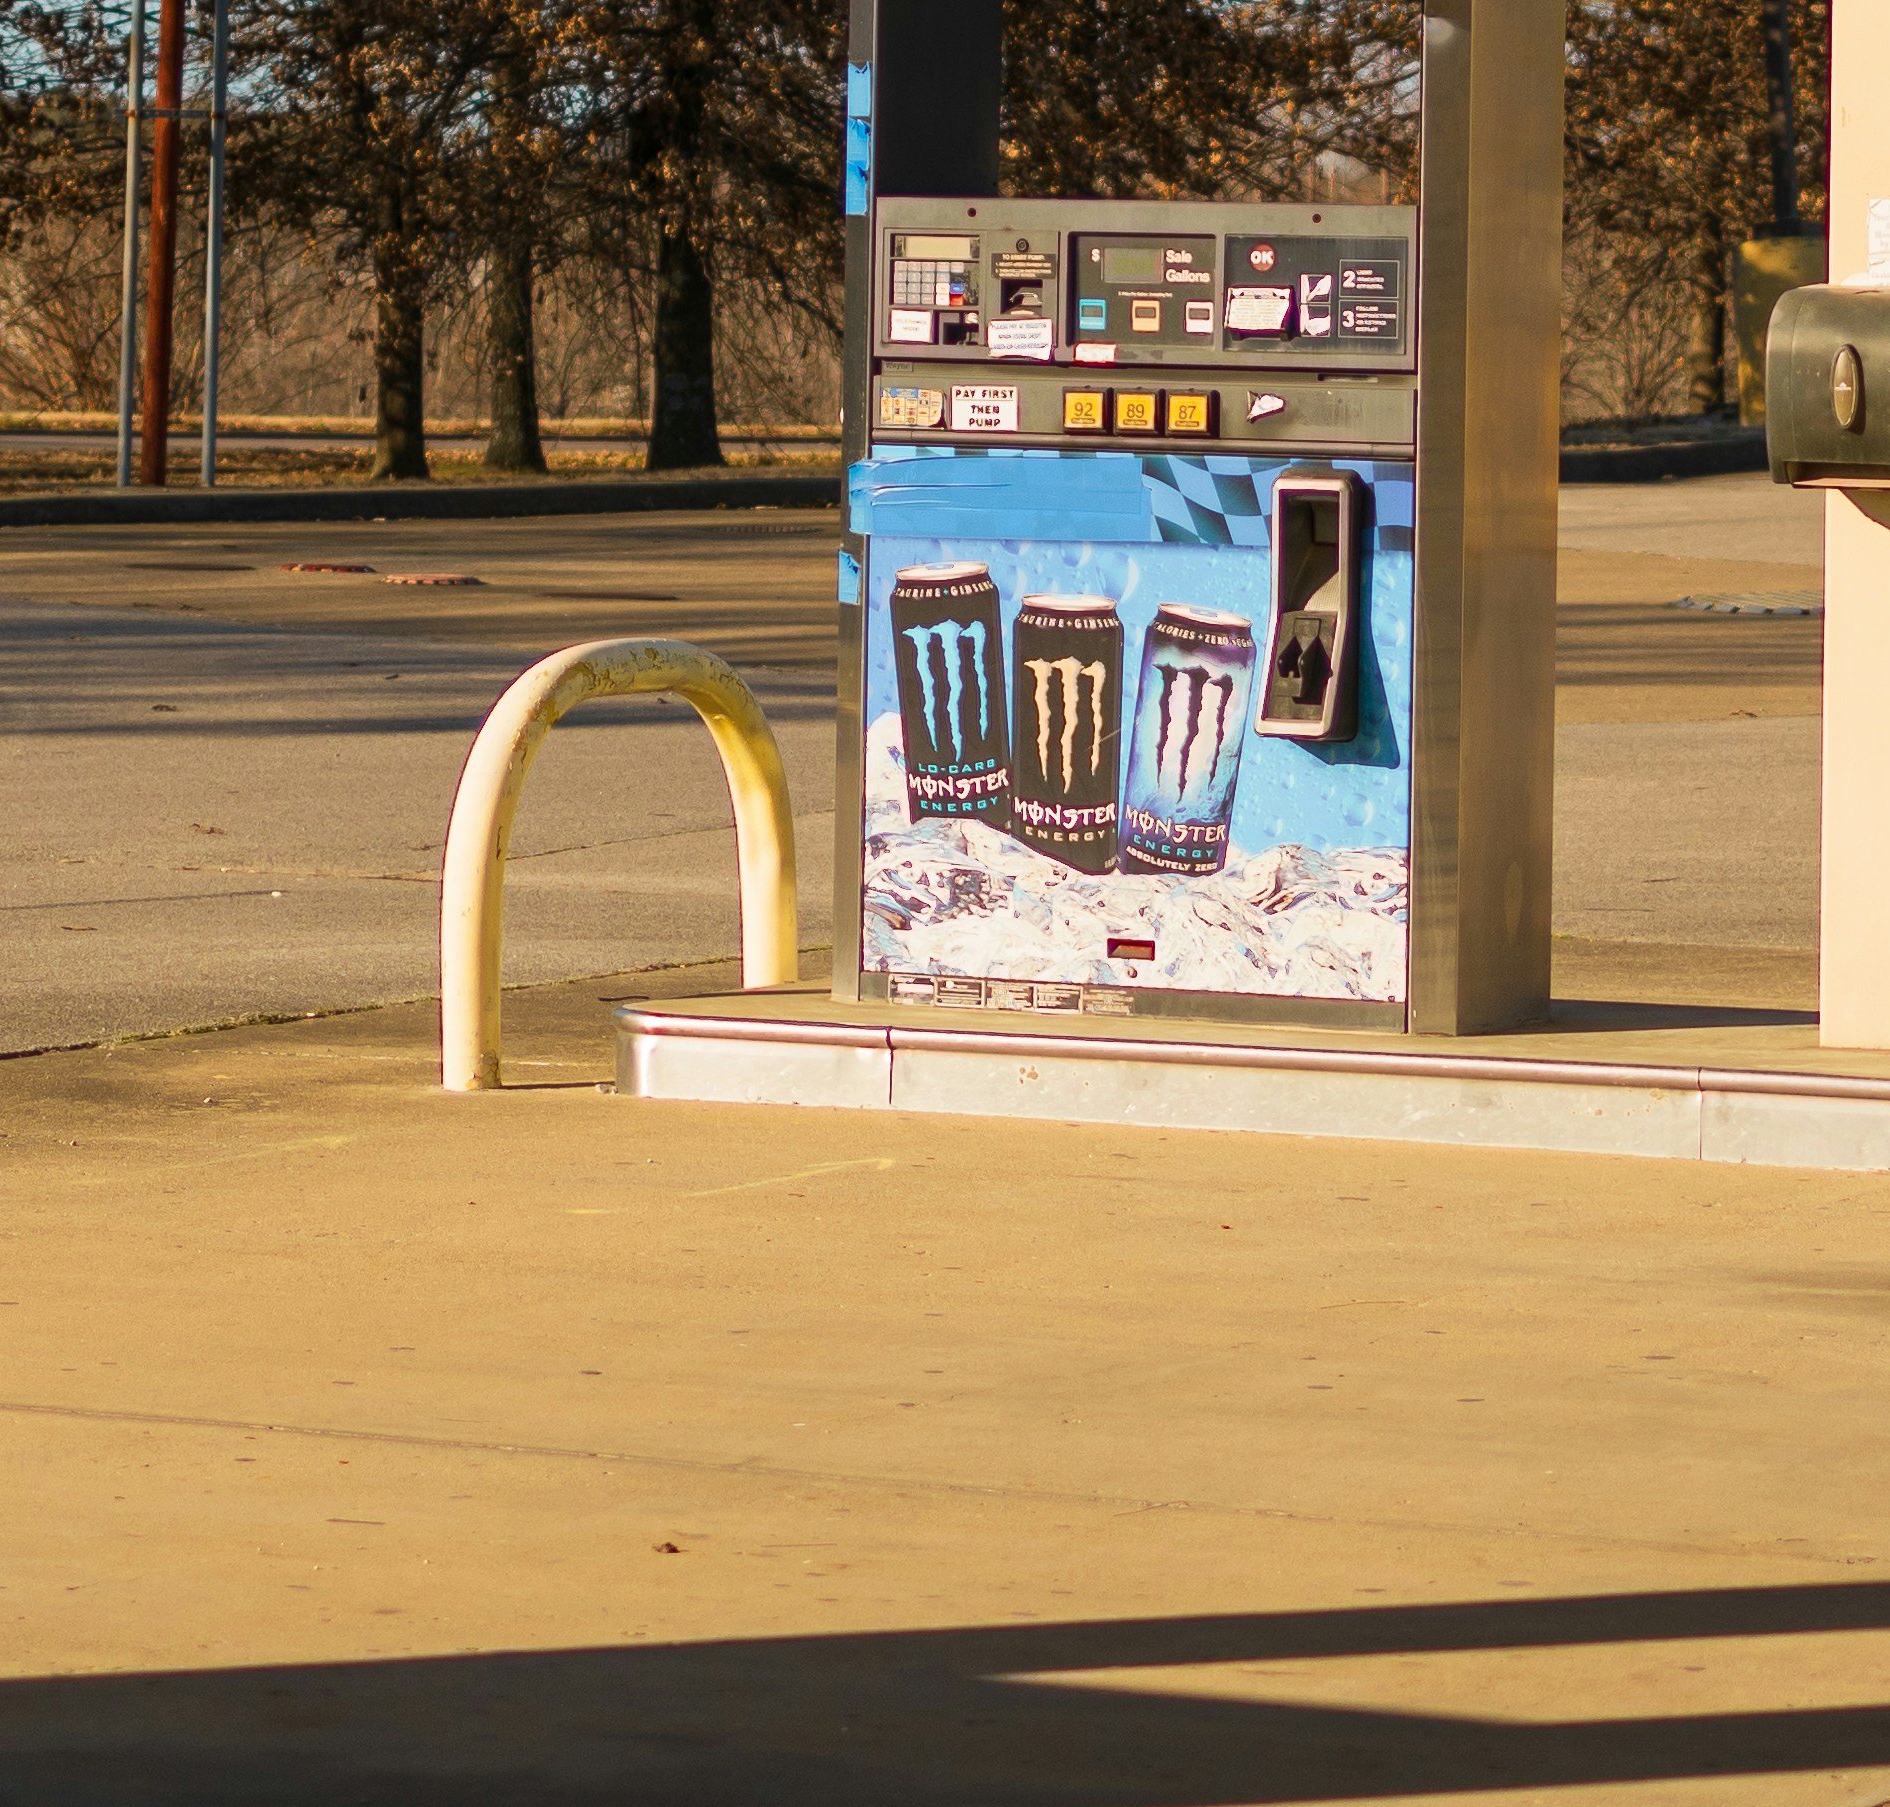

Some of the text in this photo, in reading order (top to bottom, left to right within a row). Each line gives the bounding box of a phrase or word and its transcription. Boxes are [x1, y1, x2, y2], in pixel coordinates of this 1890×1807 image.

[1165, 249, 1192, 263] Sale
[1250, 250, 1274, 265] OK
[1165, 269, 1210, 282] Gallons
[1342, 270, 1356, 288] 2
[1342, 310, 1355, 328] 3
[955, 389, 1014, 399] PAY FIRST
[970, 405, 1000, 414] THEN
[1074, 402, 1093, 417] 92
[1126, 403, 1145, 419] 89
[1178, 405, 1197, 420] 87
[969, 418, 1000, 427] PUMP
[918, 758, 996, 773] LO-CARB
[920, 796, 998, 812] ENERGY
[1025, 825, 1105, 842] ENERGY
[1133, 834, 1213, 858] ENERGY
[1126, 845, 1191, 871] ABSOLUTELY
[1194, 862, 1218, 872] ZERO
